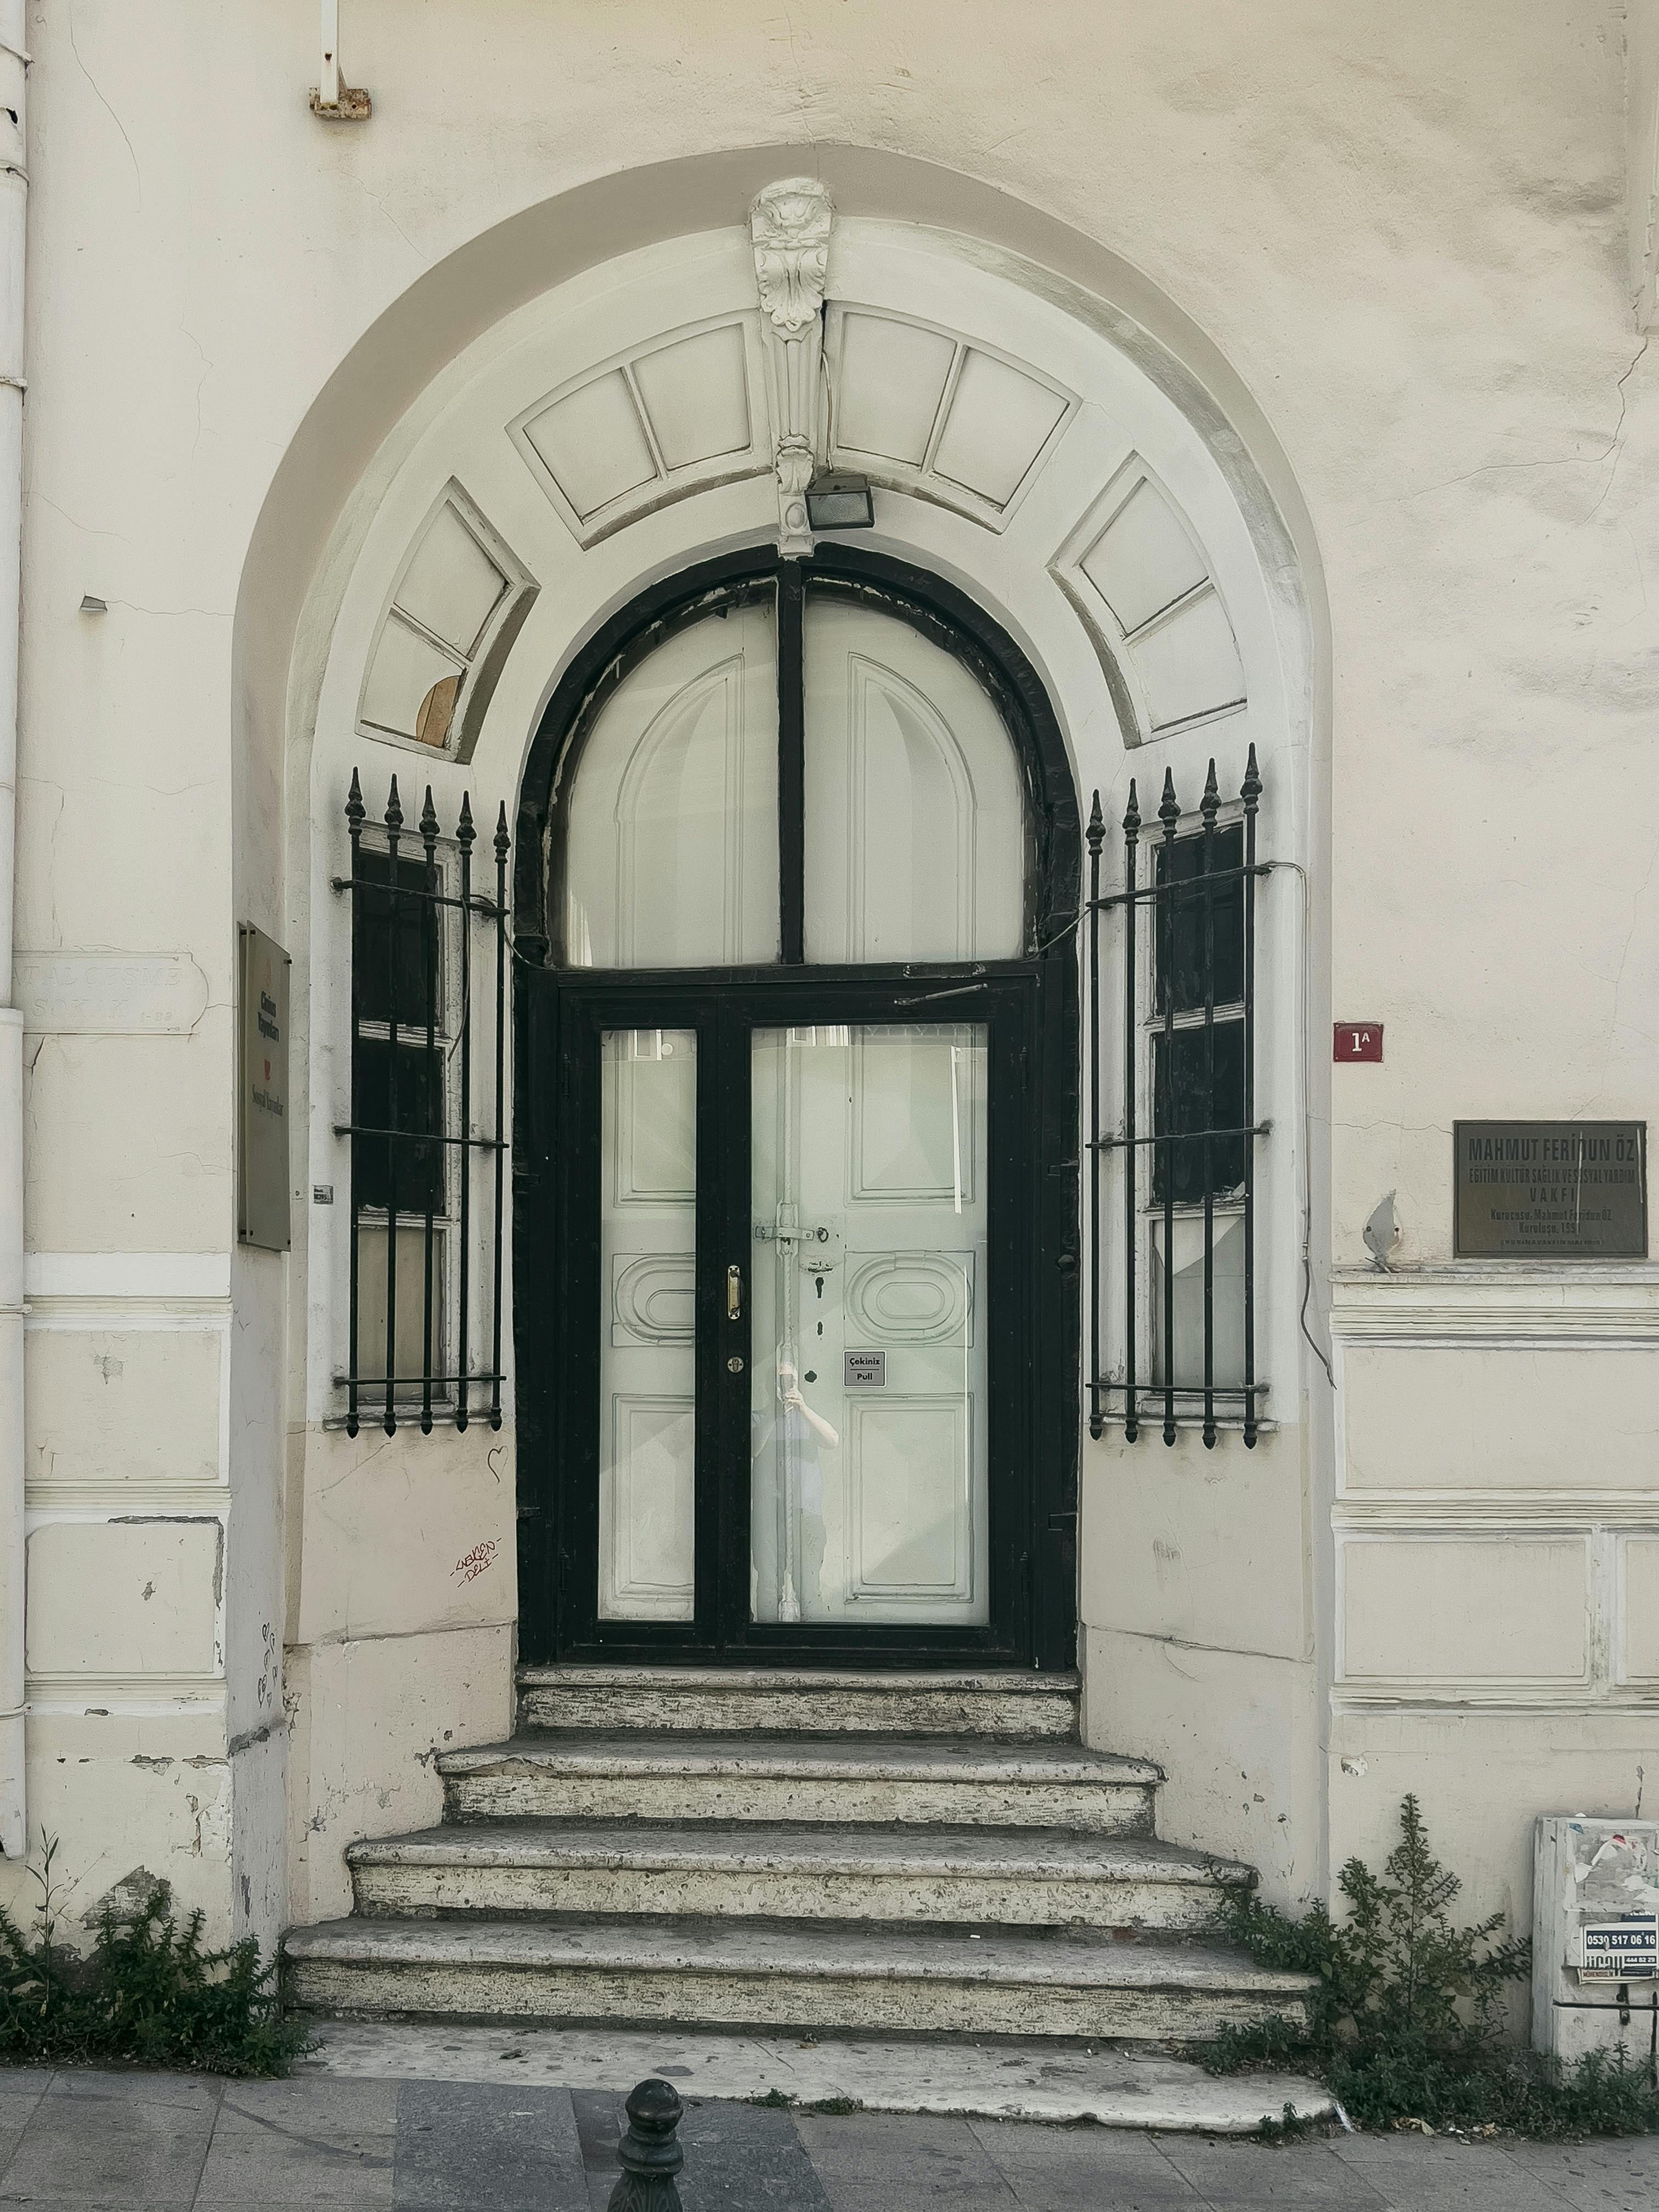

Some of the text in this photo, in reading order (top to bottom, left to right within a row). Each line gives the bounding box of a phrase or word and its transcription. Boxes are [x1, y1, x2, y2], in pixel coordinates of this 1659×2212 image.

[1469, 1138, 1539, 1161] MAHMUT
[1616, 1134, 1635, 1161] ÖZ
[849, 1357, 881, 1367] Çekiniz
[1587, 1935, 1656, 1945] 0530 517 06 16
